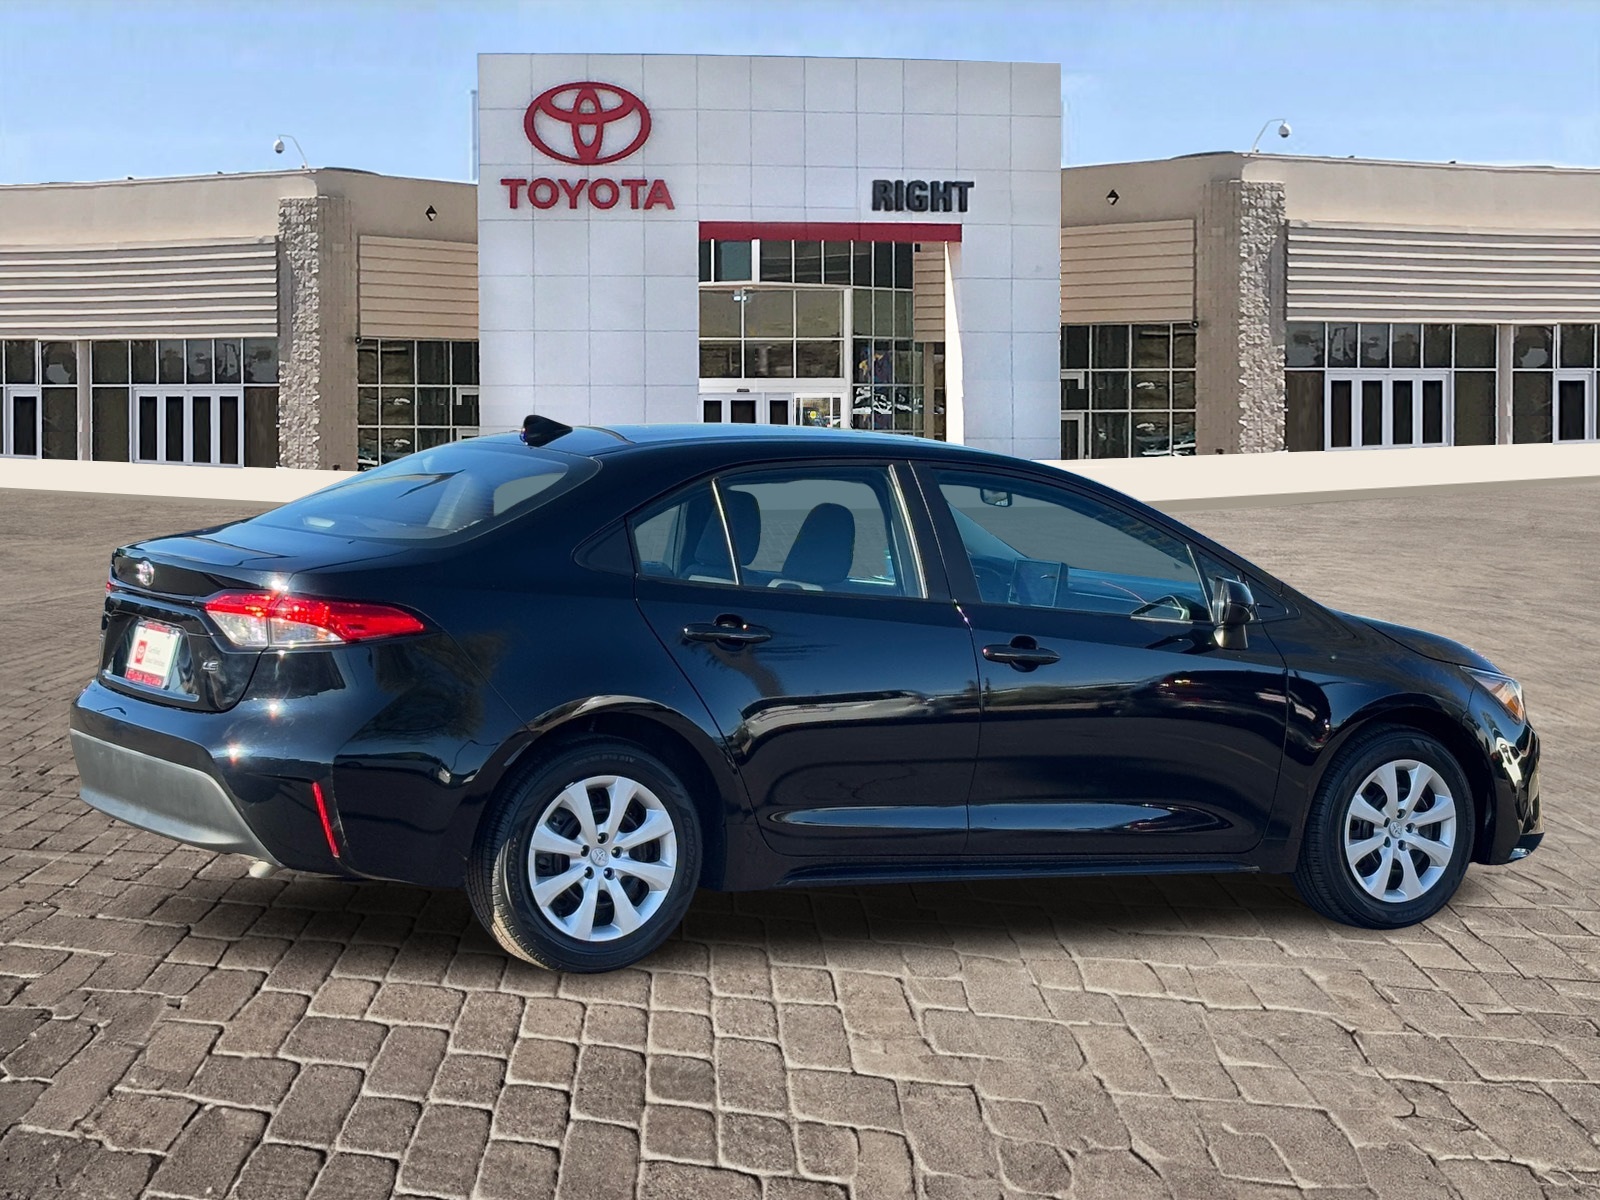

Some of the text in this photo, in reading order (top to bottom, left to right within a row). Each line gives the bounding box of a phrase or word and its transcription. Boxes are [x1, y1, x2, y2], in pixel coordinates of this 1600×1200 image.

[500, 178, 675, 210] TOYOTA
[871, 179, 975, 213] RIGHT
[202, 660, 219, 671] LE
